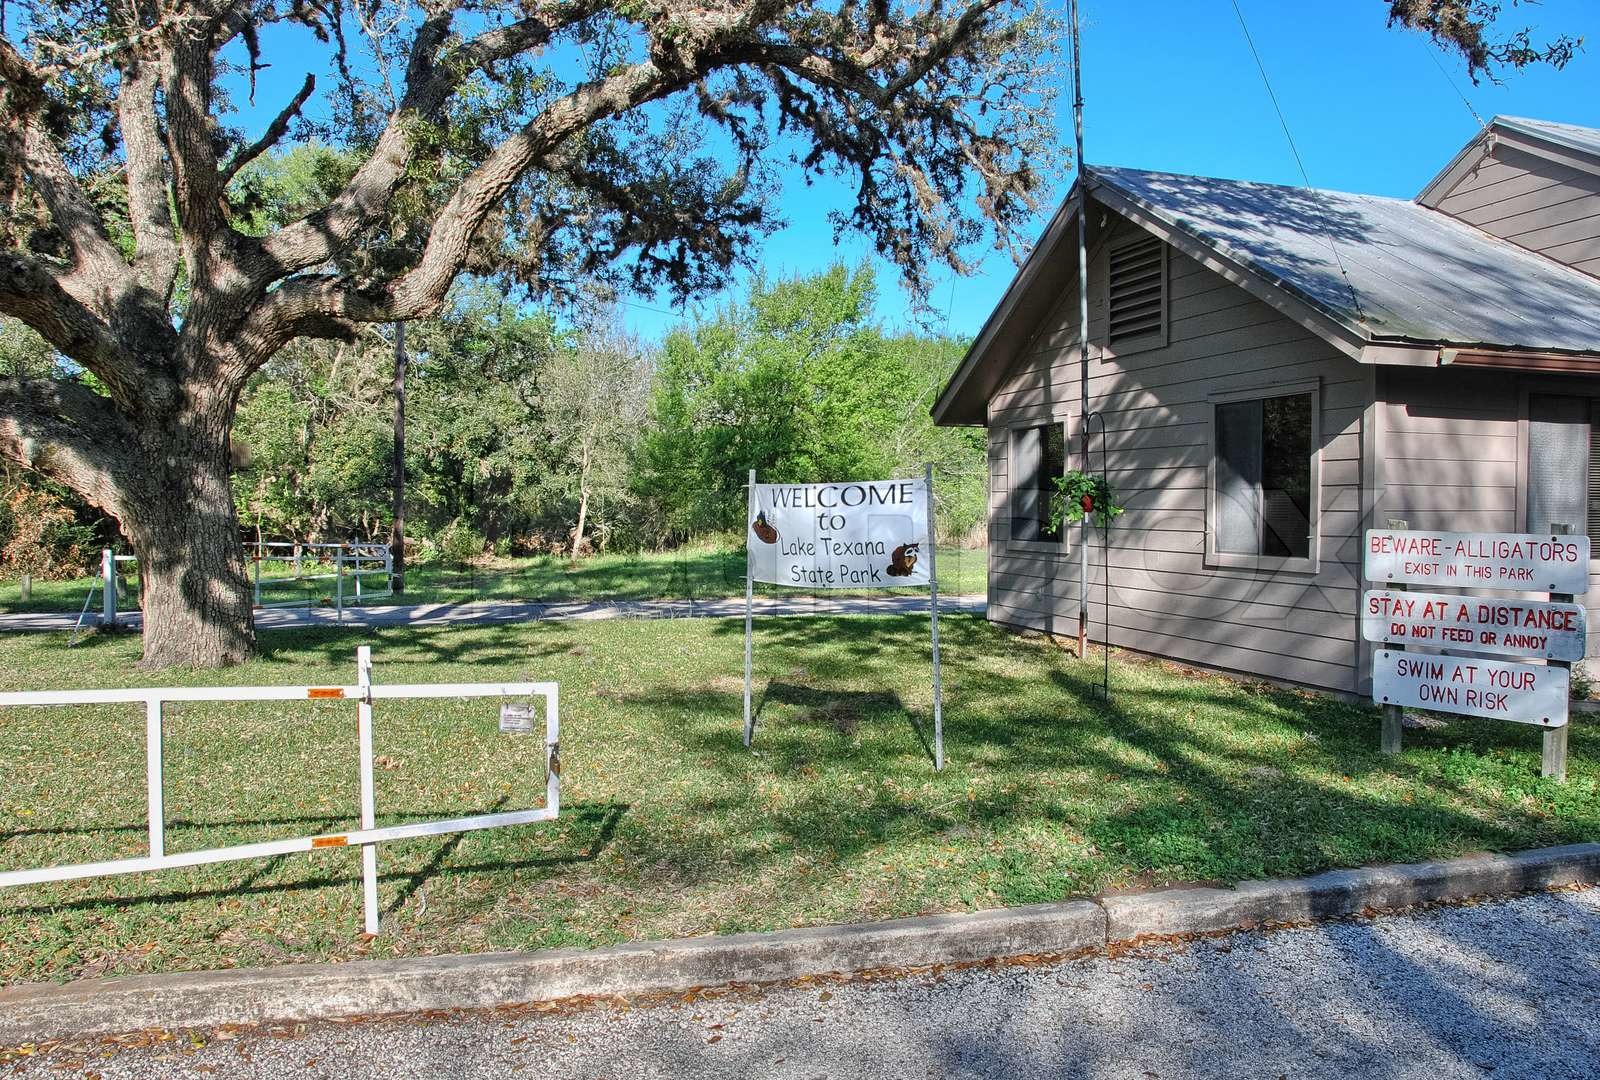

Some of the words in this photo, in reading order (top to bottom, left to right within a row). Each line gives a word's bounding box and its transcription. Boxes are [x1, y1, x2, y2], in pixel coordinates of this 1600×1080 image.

[772, 483, 913, 508] WELCOME
[817, 512, 846, 531] to
[781, 537, 816, 556] Lake
[820, 537, 885, 556] Texana
[791, 565, 835, 584] State
[840, 564, 881, 583] Park
[1405, 562, 1440, 576] EXIST
[1446, 564, 1457, 576] IN
[1464, 565, 1492, 579] THIS
[1500, 567, 1534, 581] PARK
[1369, 597, 1415, 617] STAY
[1423, 602, 1448, 621] AT
[1456, 604, 1470, 623] A
[1478, 605, 1578, 632] DISTANCE
[1391, 622, 1406, 636] DO
[1411, 625, 1436, 639] NOT
[1442, 627, 1474, 642] FEED
[1480, 631, 1497, 645] OR
[1503, 633, 1548, 650] ANNOY
[1397, 659, 1444, 680] SWIM
[1452, 666, 1478, 684] AT
[1488, 668, 1536, 691] YOUR
[1419, 684, 1458, 705] OWN
[1466, 690, 1508, 711] RISK
